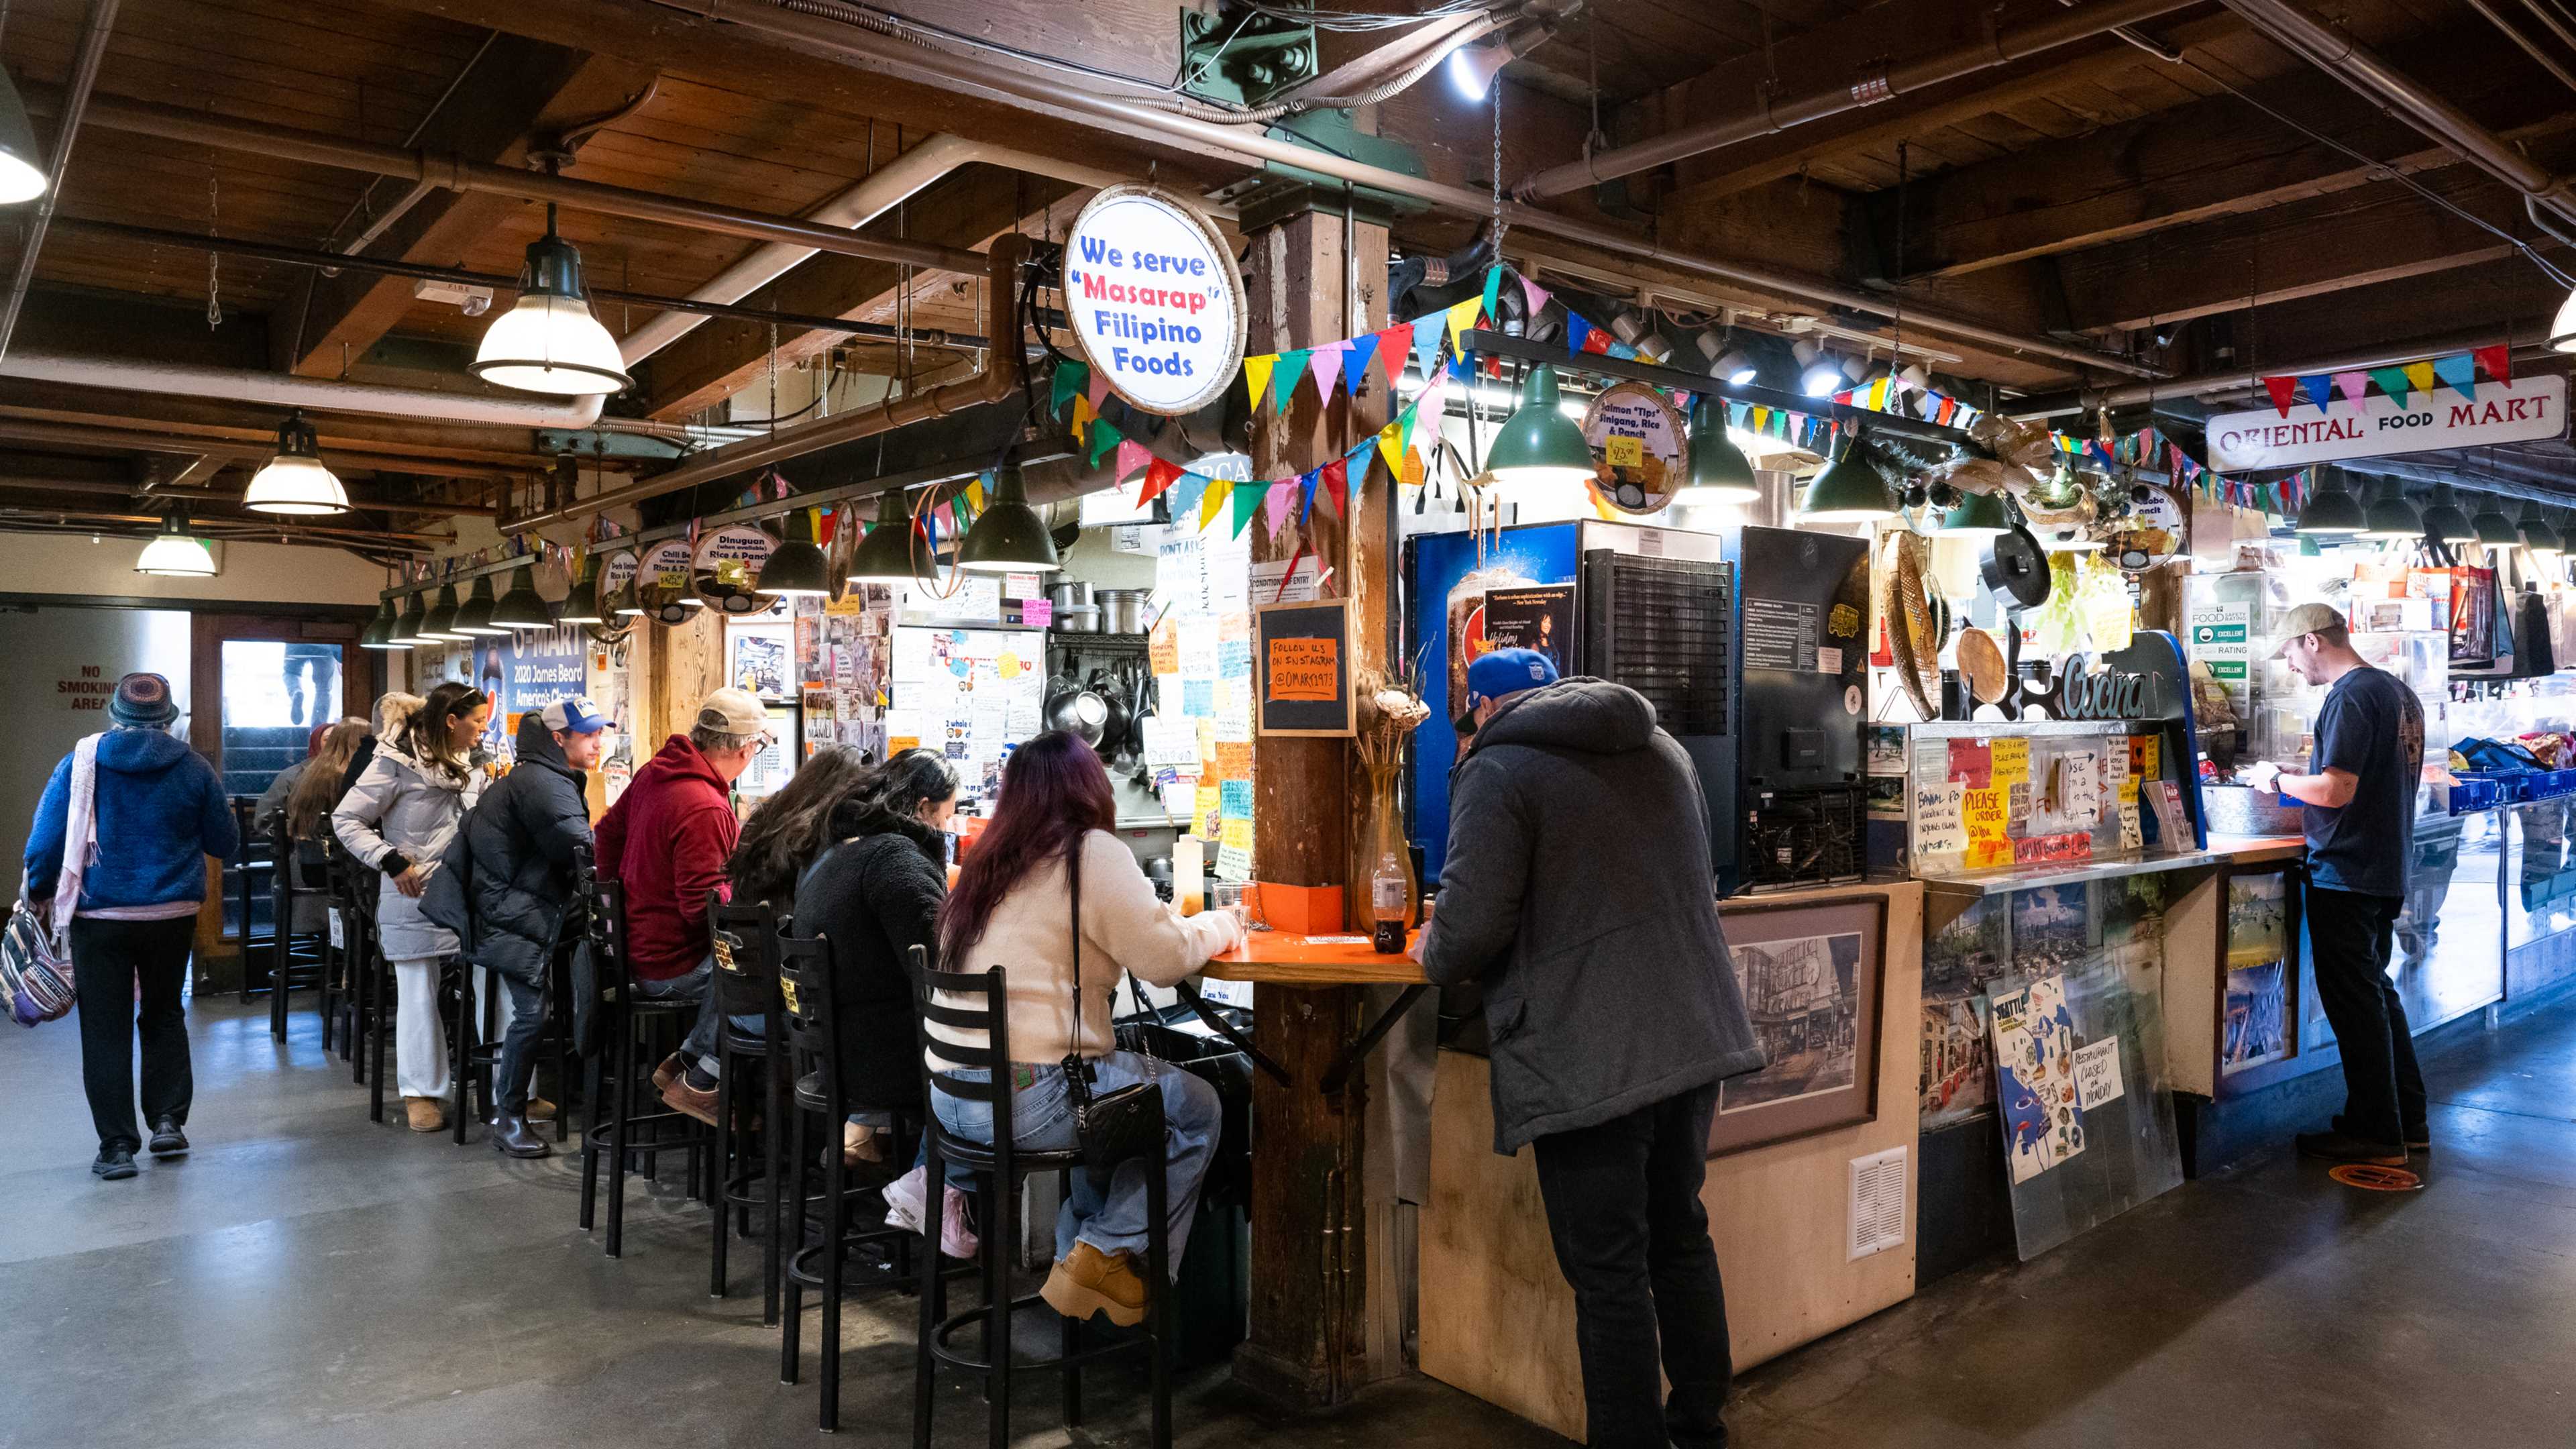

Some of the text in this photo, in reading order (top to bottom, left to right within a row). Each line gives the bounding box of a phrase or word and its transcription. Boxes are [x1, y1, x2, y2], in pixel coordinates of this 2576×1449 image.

[1081, 235, 1205, 276] We serve
[1095, 310, 1201, 343] Filipino
[1113, 347, 1193, 376] Foods
[1642, 419, 1660, 429] Rice
[2219, 395, 2551, 452] ORIENTAL FOOD MART
[1609, 427, 1615, 435] &
[719, 536, 765, 545] Dinuguan
[732, 551, 739, 559] &
[1293, 575, 1309, 585] ENTRY
[2192, 613, 2224, 623] FOOD
[1273, 642, 1326, 654] FOLLOW US
[2218, 646, 2247, 655] RATING
[1273, 655, 1336, 667] ON INSTAGRAM
[82, 665, 100, 678] NO
[515, 661, 583, 684] 2020 James Beard
[2062, 653, 2147, 720] Cucina
[1949, 790, 1960, 803] PO
[1965, 792, 2000, 812] PLEASE
[1975, 810, 2002, 822] ORDER
[2075, 1042, 2114, 1067] RESTAURANT
[2080, 1059, 2107, 1083] CLOSED
[2090, 1079, 2099, 1087] ON
[2086, 1079, 2112, 1107] MONDAY
